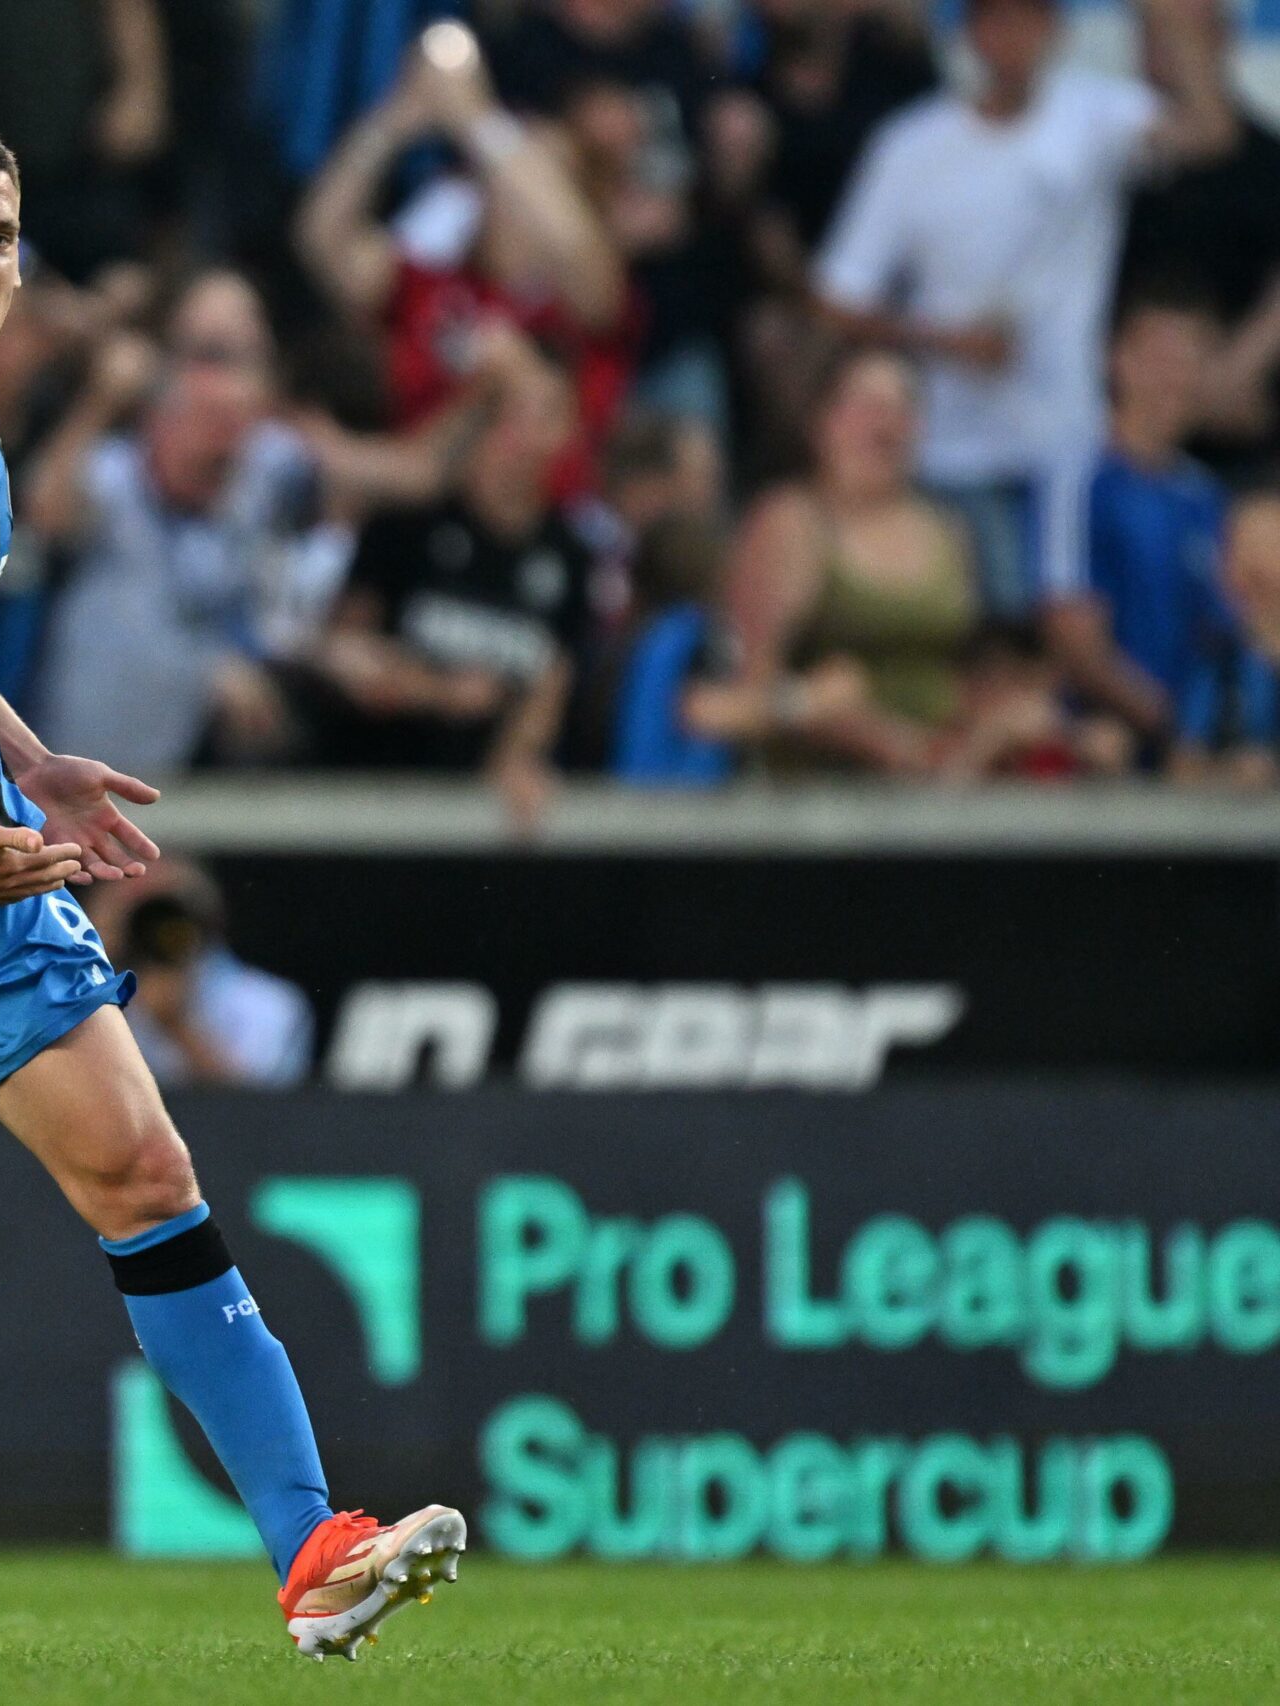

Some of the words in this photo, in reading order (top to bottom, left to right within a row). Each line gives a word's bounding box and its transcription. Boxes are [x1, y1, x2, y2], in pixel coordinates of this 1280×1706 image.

[477, 1174, 735, 1348] Pro
[763, 1173, 1280, 1390] League
[478, 1395, 1173, 1564] Supercup
